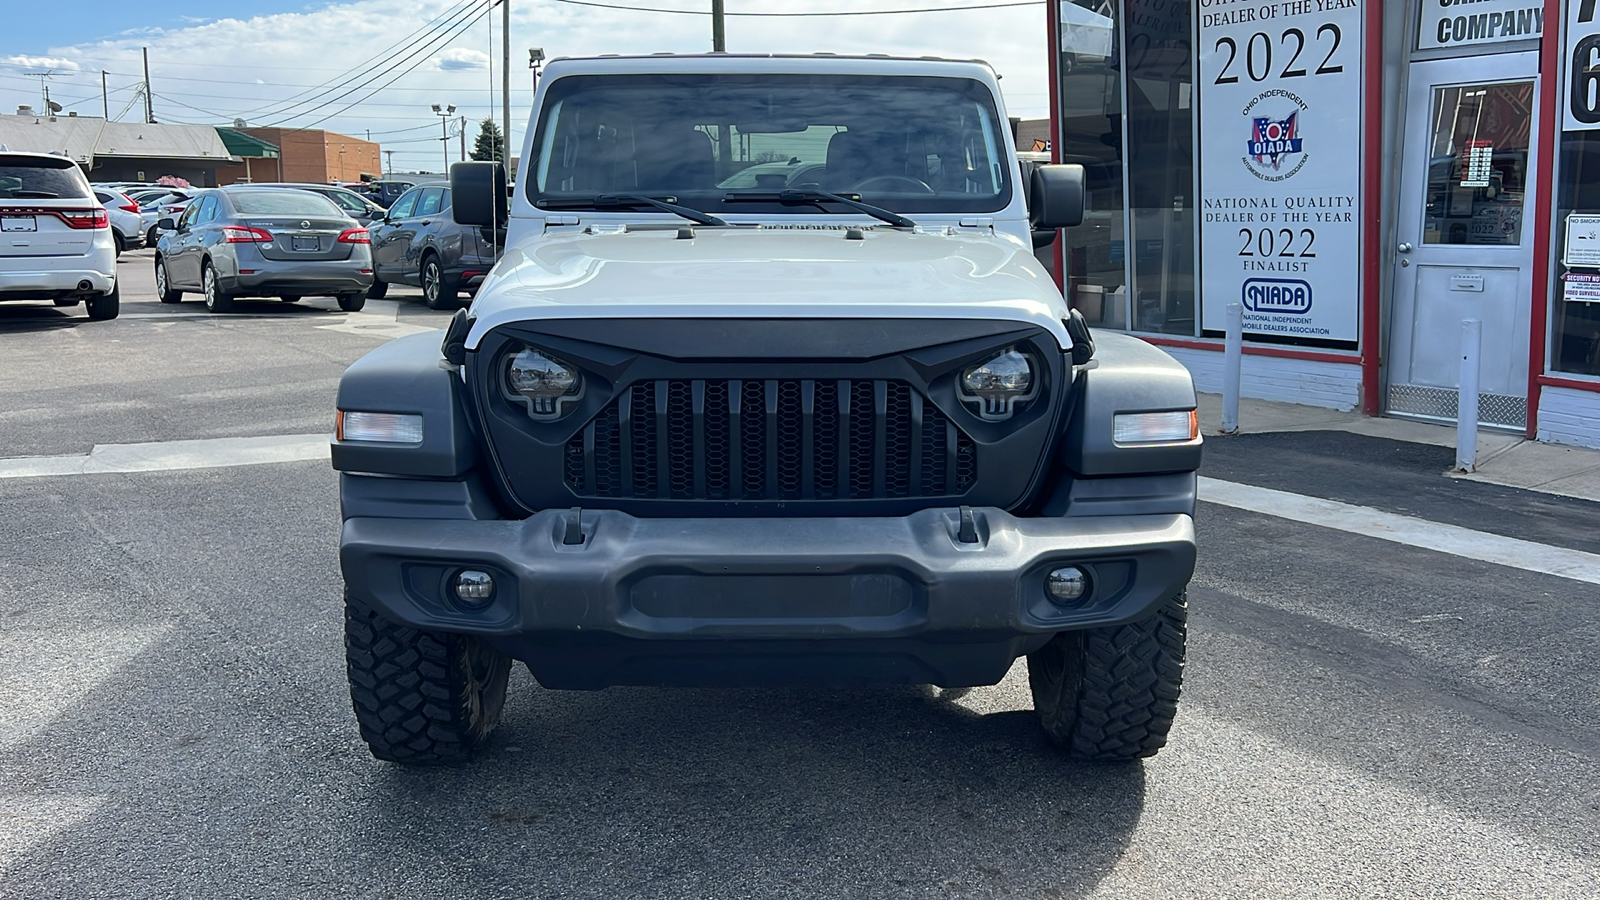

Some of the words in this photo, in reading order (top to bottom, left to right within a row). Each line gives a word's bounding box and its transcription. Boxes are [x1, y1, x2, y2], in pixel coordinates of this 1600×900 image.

[1203, 8, 1256, 28] DEALER
[1259, 5, 1278, 20] OF
[1282, 0, 1312, 17] THE
[1437, 7, 1544, 43] COMPANY
[1214, 23, 1343, 85] 2022
[1242, 97, 1259, 116] OHIO
[1259, 89, 1309, 111] INDEPENDENT
[1254, 140, 1293, 154] OIADA
[1241, 157, 1264, 181] AUTOMOBILE
[1285, 153, 1309, 179] ASSOCIATION
[1204, 198, 1278, 209] NATIONAL
[1285, 196, 1354, 210] QUALITY
[1205, 213, 1254, 222] DEALER
[1260, 213, 1277, 222] OF
[1283, 213, 1309, 222] THE
[1315, 212, 1352, 222] YEAR
[1238, 228, 1316, 258] 2022
[1243, 261, 1309, 272] FINALIST
[1248, 286, 1305, 307] NIADA
[1263, 324, 1288, 332] DEALERS
[1289, 326, 1330, 335] ASSOCIATION
[1272, 316, 1312, 324] INDEPENDENT
